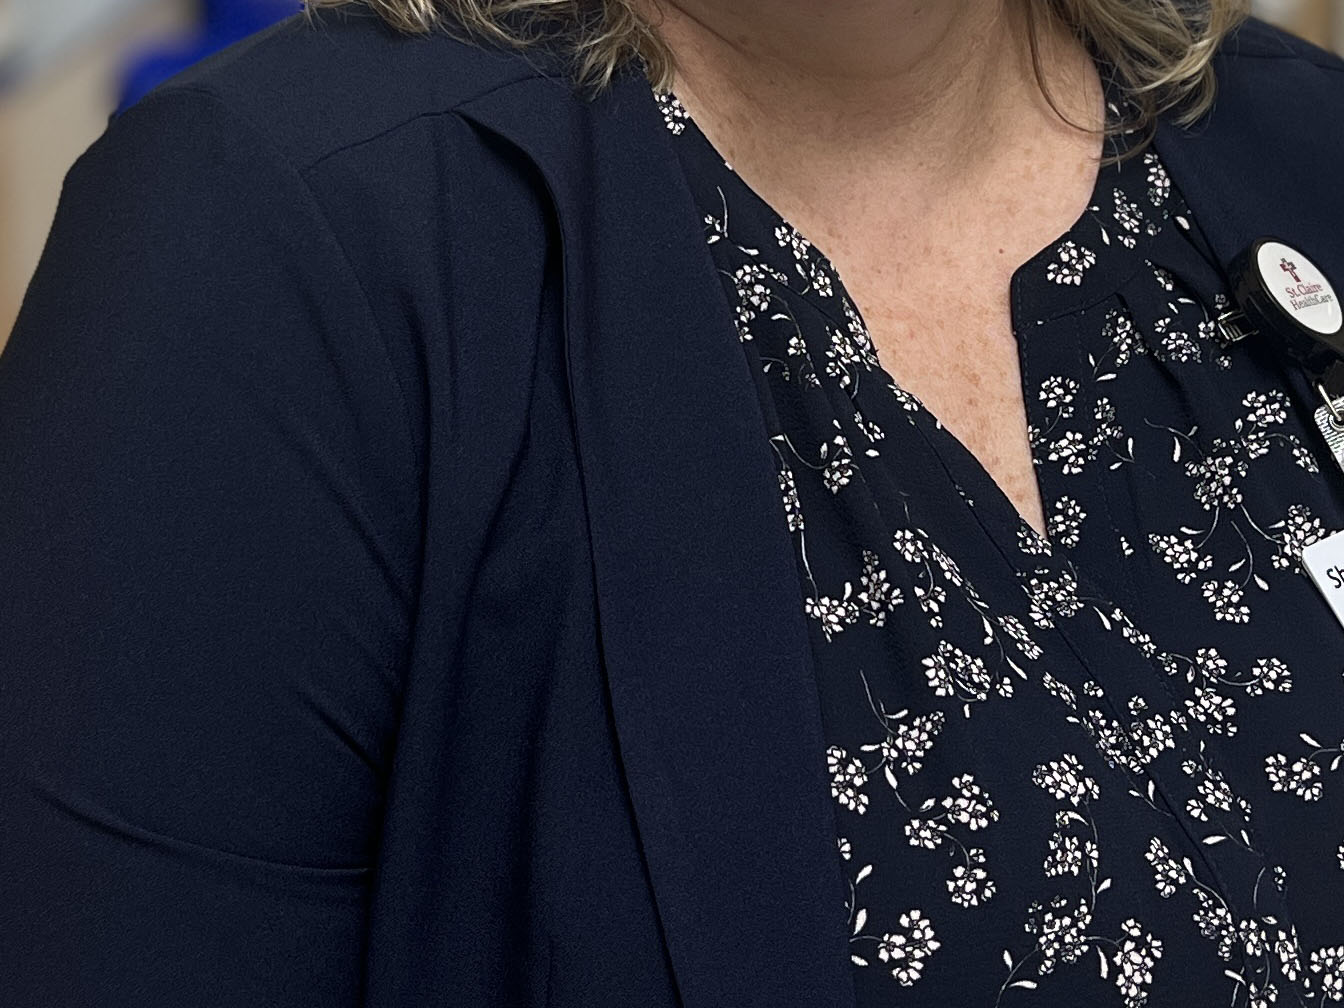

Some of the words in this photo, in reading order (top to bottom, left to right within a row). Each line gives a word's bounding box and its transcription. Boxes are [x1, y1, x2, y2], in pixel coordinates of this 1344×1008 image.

[1285, 286, 1300, 299] St.
[1297, 282, 1324, 296] Claire
[1289, 294, 1334, 311] HealthCare
